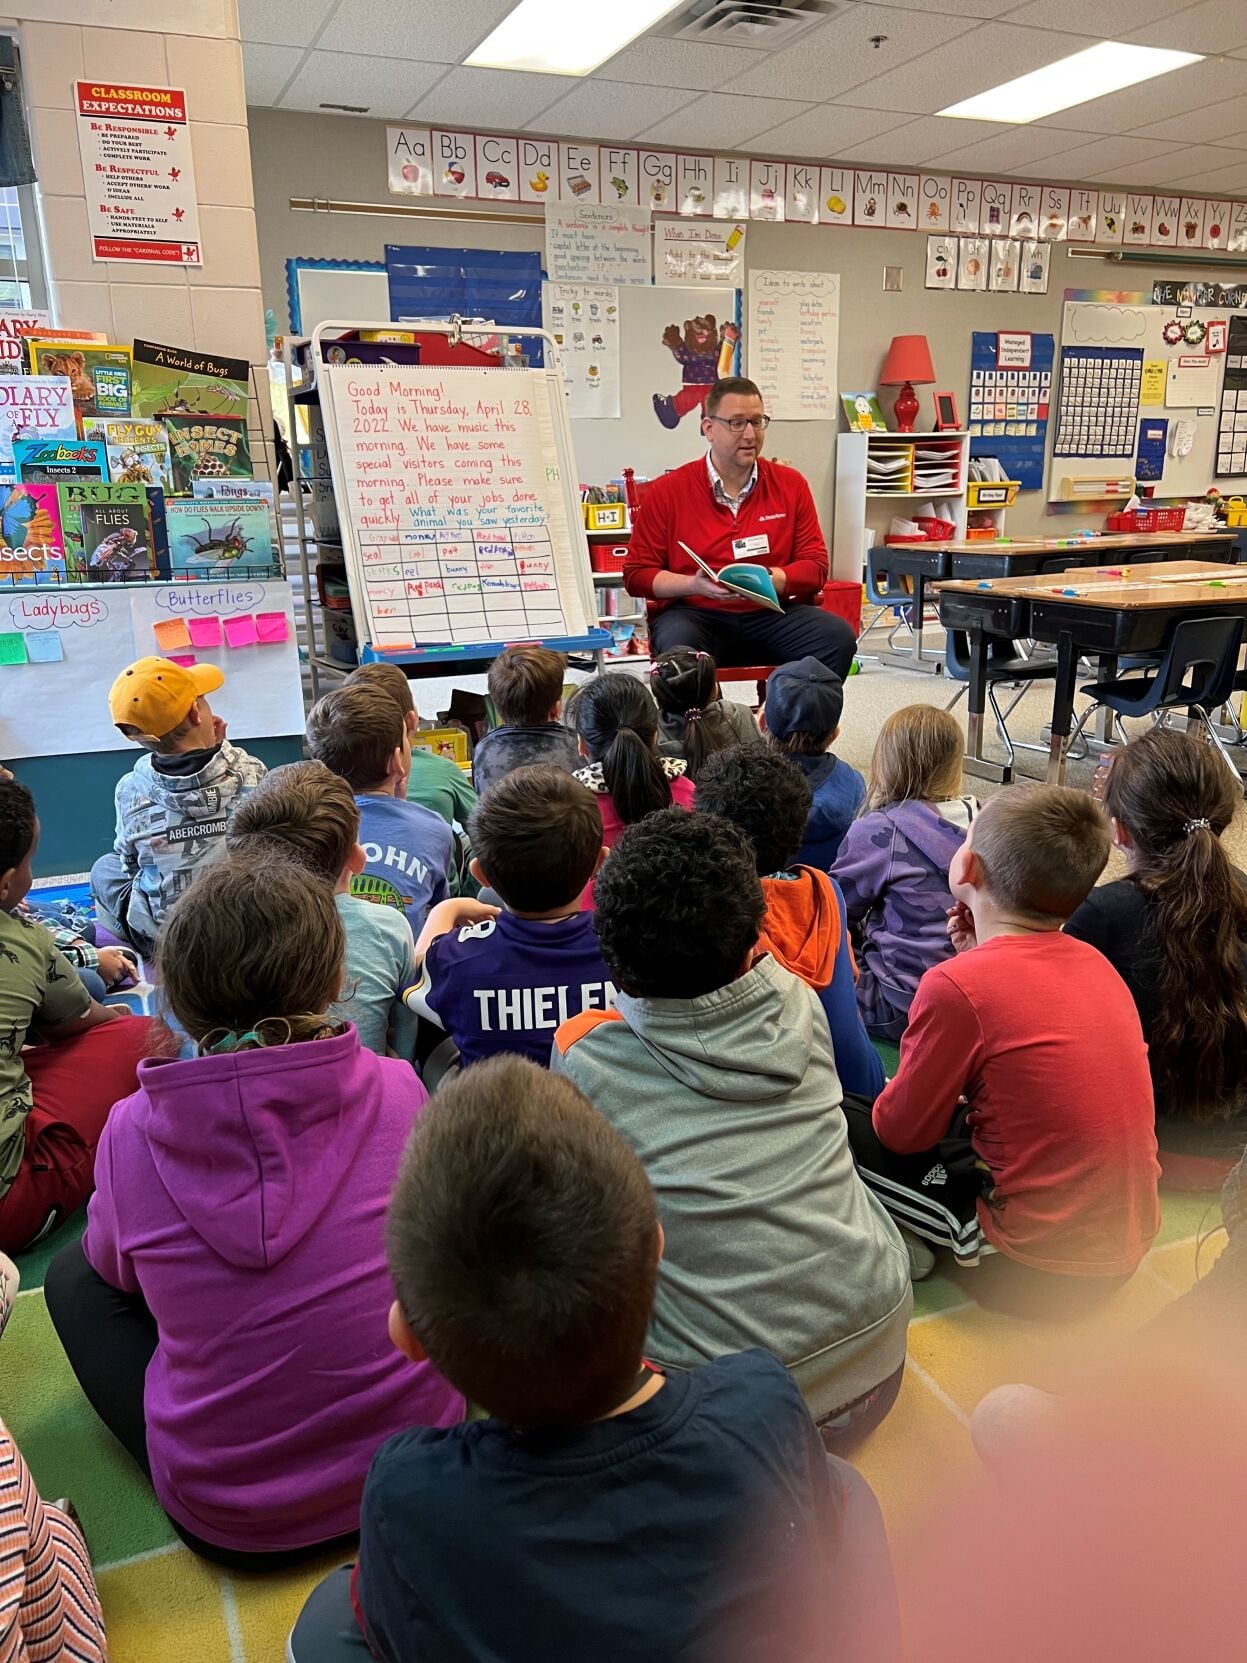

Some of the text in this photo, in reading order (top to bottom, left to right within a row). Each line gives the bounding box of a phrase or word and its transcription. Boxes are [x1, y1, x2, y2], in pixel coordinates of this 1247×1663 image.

[92, 87, 171, 103] CLASSROOM
[82, 100, 182, 117] EXPECTATIONS
[395, 132, 425, 156] Aa
[441, 135, 466, 159] Bb
[483, 140, 511, 164] Cc
[524, 143, 551, 166] Dd
[567, 147, 591, 171] Ee
[609, 152, 629, 173] Ff
[643, 154, 672, 185] Gg
[683, 158, 707, 181] Hh
[725, 161, 739, 183] Ii
[759, 165, 778, 194] Jj
[793, 168, 813, 190] Kk
[857, 174, 885, 195] Mm
[892, 177, 914, 198] Nn
[923, 178, 947, 199] Oo
[957, 181, 975, 210] Pp
[983, 185, 1009, 215] Qq
[1019, 187, 1034, 207] Rr
[1049, 189, 1062, 210] Ss
[1078, 191, 1091, 212] Tt
[1103, 195, 1121, 215] Uu
[114, 206, 135, 214] SAFE
[579, 210, 613, 220] Sentences
[1132, 197, 1150, 216] Vv
[1155, 199, 1179, 219] Ww
[1184, 200, 1199, 219] Xx
[1211, 203, 1225, 225] Yy
[664, 228, 684, 238] When
[558, 287, 613, 298] Tricky words
[156, 352, 229, 377] A World of Bugs
[96, 375, 127, 384] FIRST
[0, 386, 67, 406] DIARY
[96, 383, 127, 397] BIG
[348, 382, 445, 401] Good Morning!
[19, 408, 60, 427] FLY
[352, 400, 388, 421] Today
[398, 403, 406, 414] is
[410, 400, 469, 419] Thursday,
[477, 400, 504, 418] April
[107, 423, 162, 436] FLY GUY
[398, 419, 418, 432] We
[425, 418, 451, 432] have
[458, 422, 489, 432] music
[495, 419, 516, 432] this
[168, 426, 243, 445] INSECT
[416, 436, 436, 450] We
[446, 436, 470, 450] have
[478, 441, 505, 449] some
[22, 443, 98, 464] Zoobooks
[356, 453, 522, 474] special visitors coming this
[418, 473, 453, 486] Please
[463, 472, 491, 486] make
[500, 475, 523, 484] sure
[66, 487, 140, 502] BUG
[221, 485, 247, 498] Bugs
[359, 490, 537, 512] to get all of your jobs done
[96, 514, 130, 524] FLIES
[410, 504, 544, 519] What was your favorite
[414, 518, 447, 527] animal
[456, 518, 473, 529] you
[503, 513, 550, 528] yesterday?
[0, 543, 62, 561] sects
[446, 564, 468, 574] bunny
[168, 588, 253, 607] Butterflies
[22, 598, 101, 624] Ladybugs
[169, 821, 228, 840] ABERCROMB
[361, 843, 428, 884] OHN
[922, 1164, 944, 1186] adidas
